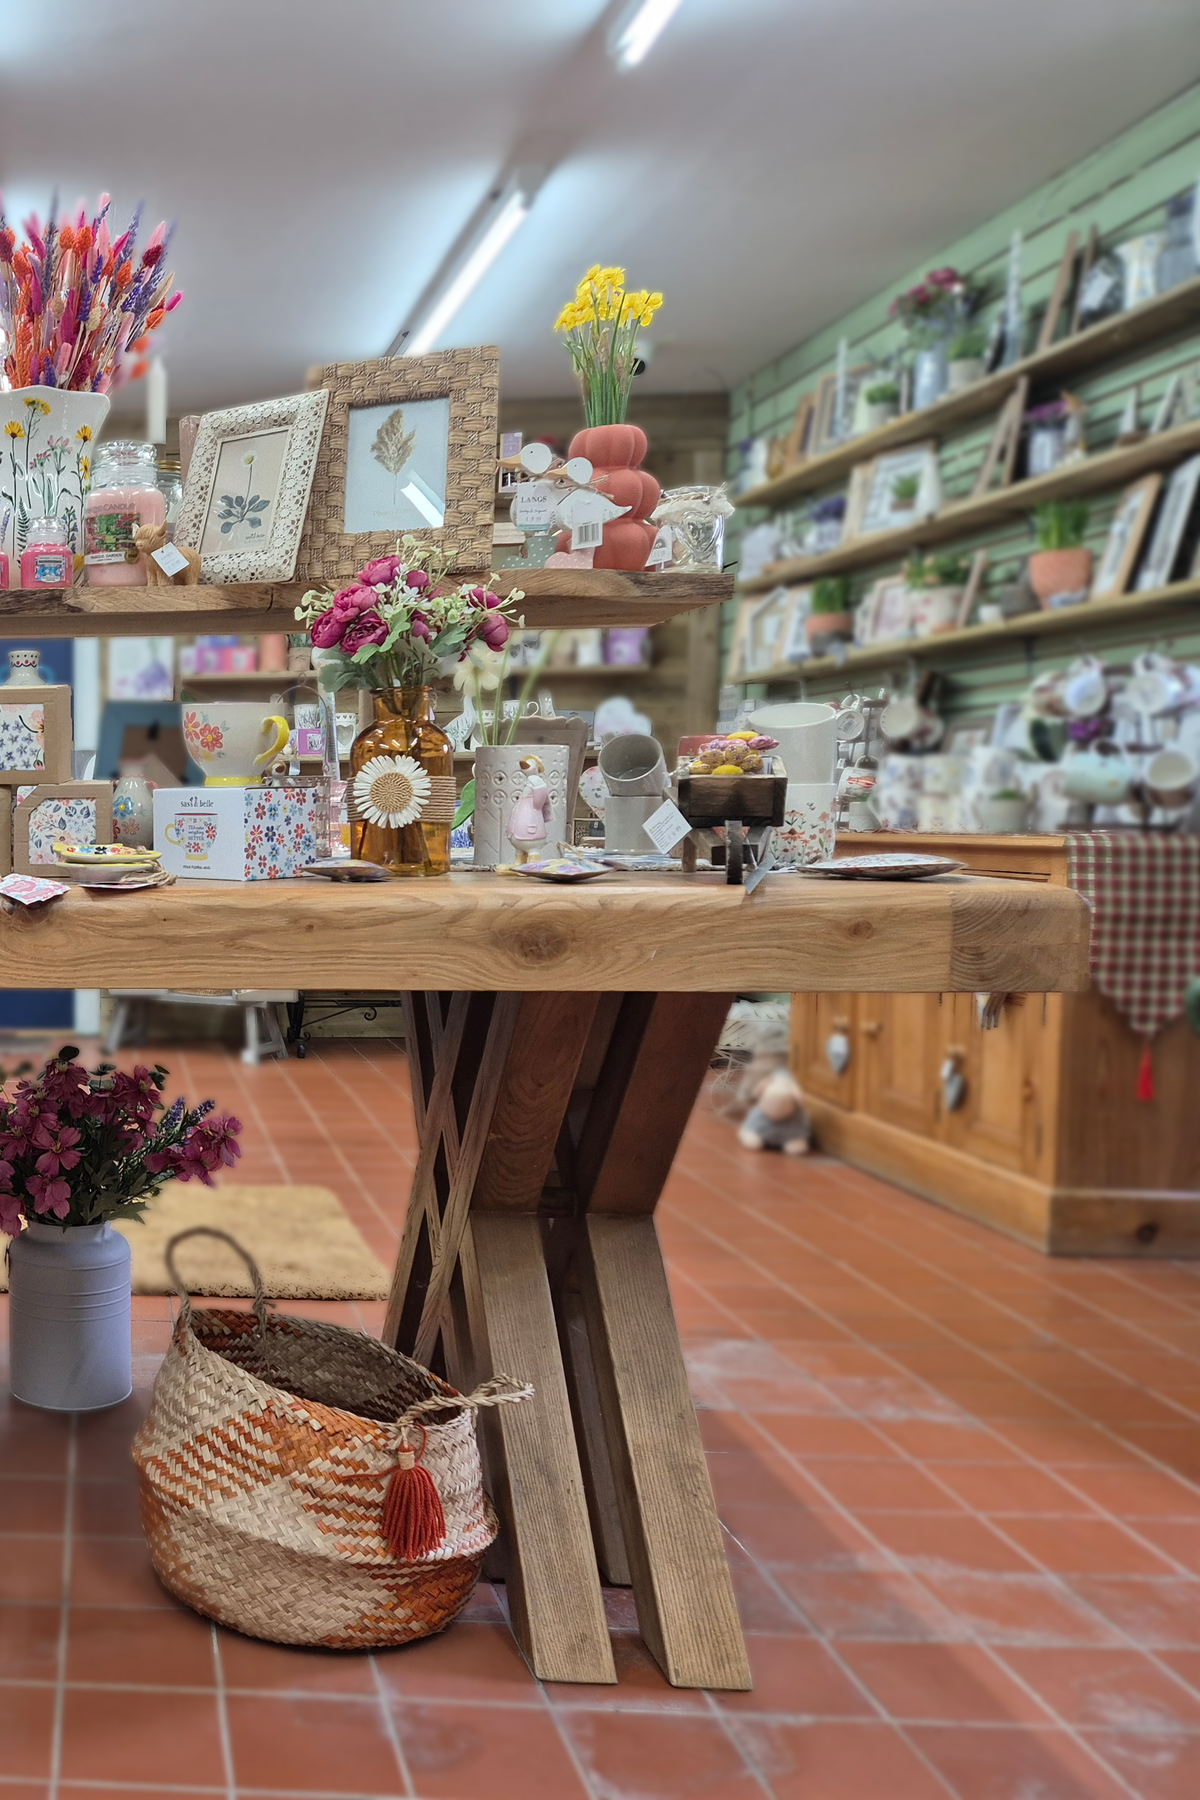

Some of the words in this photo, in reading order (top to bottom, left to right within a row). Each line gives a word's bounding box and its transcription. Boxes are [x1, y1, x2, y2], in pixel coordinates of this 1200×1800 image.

[520, 495, 548, 503] LANGS
[103, 502, 136, 510] CANDLE
[180, 800, 193, 808] sass
[199, 799, 214, 808] belle
